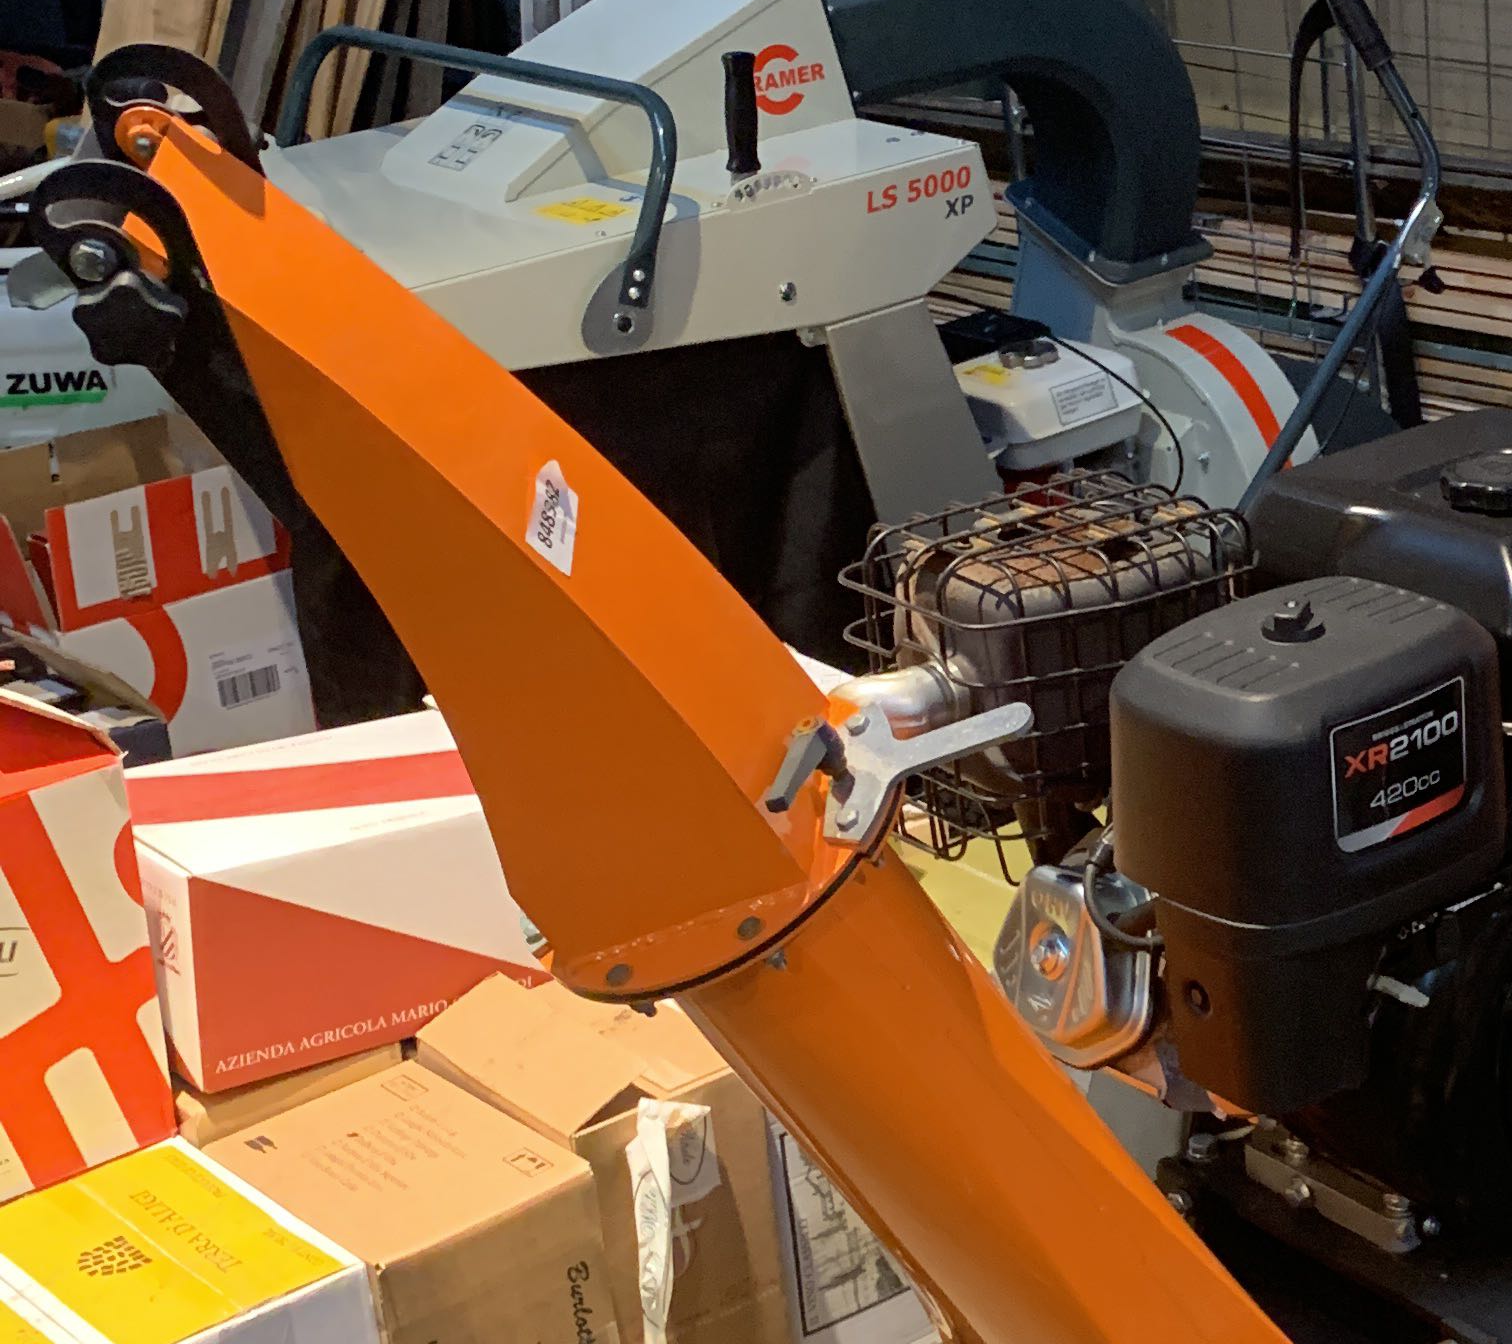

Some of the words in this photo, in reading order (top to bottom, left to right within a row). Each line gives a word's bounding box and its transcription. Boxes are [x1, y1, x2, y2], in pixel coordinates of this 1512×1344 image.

[753, 62, 825, 93] RAMER
[866, 185, 898, 214] LS
[907, 165, 971, 204] 5000
[945, 194, 974, 219] XP
[6, 370, 108, 395] ZUWA
[1344, 709, 1459, 779] XR2100
[1369, 769, 1441, 809] 420cc
[215, 1040, 296, 1074] AZIENDA
[300, 1016, 389, 1052] AGRICOLA
[391, 999, 449, 1026] MARIO
